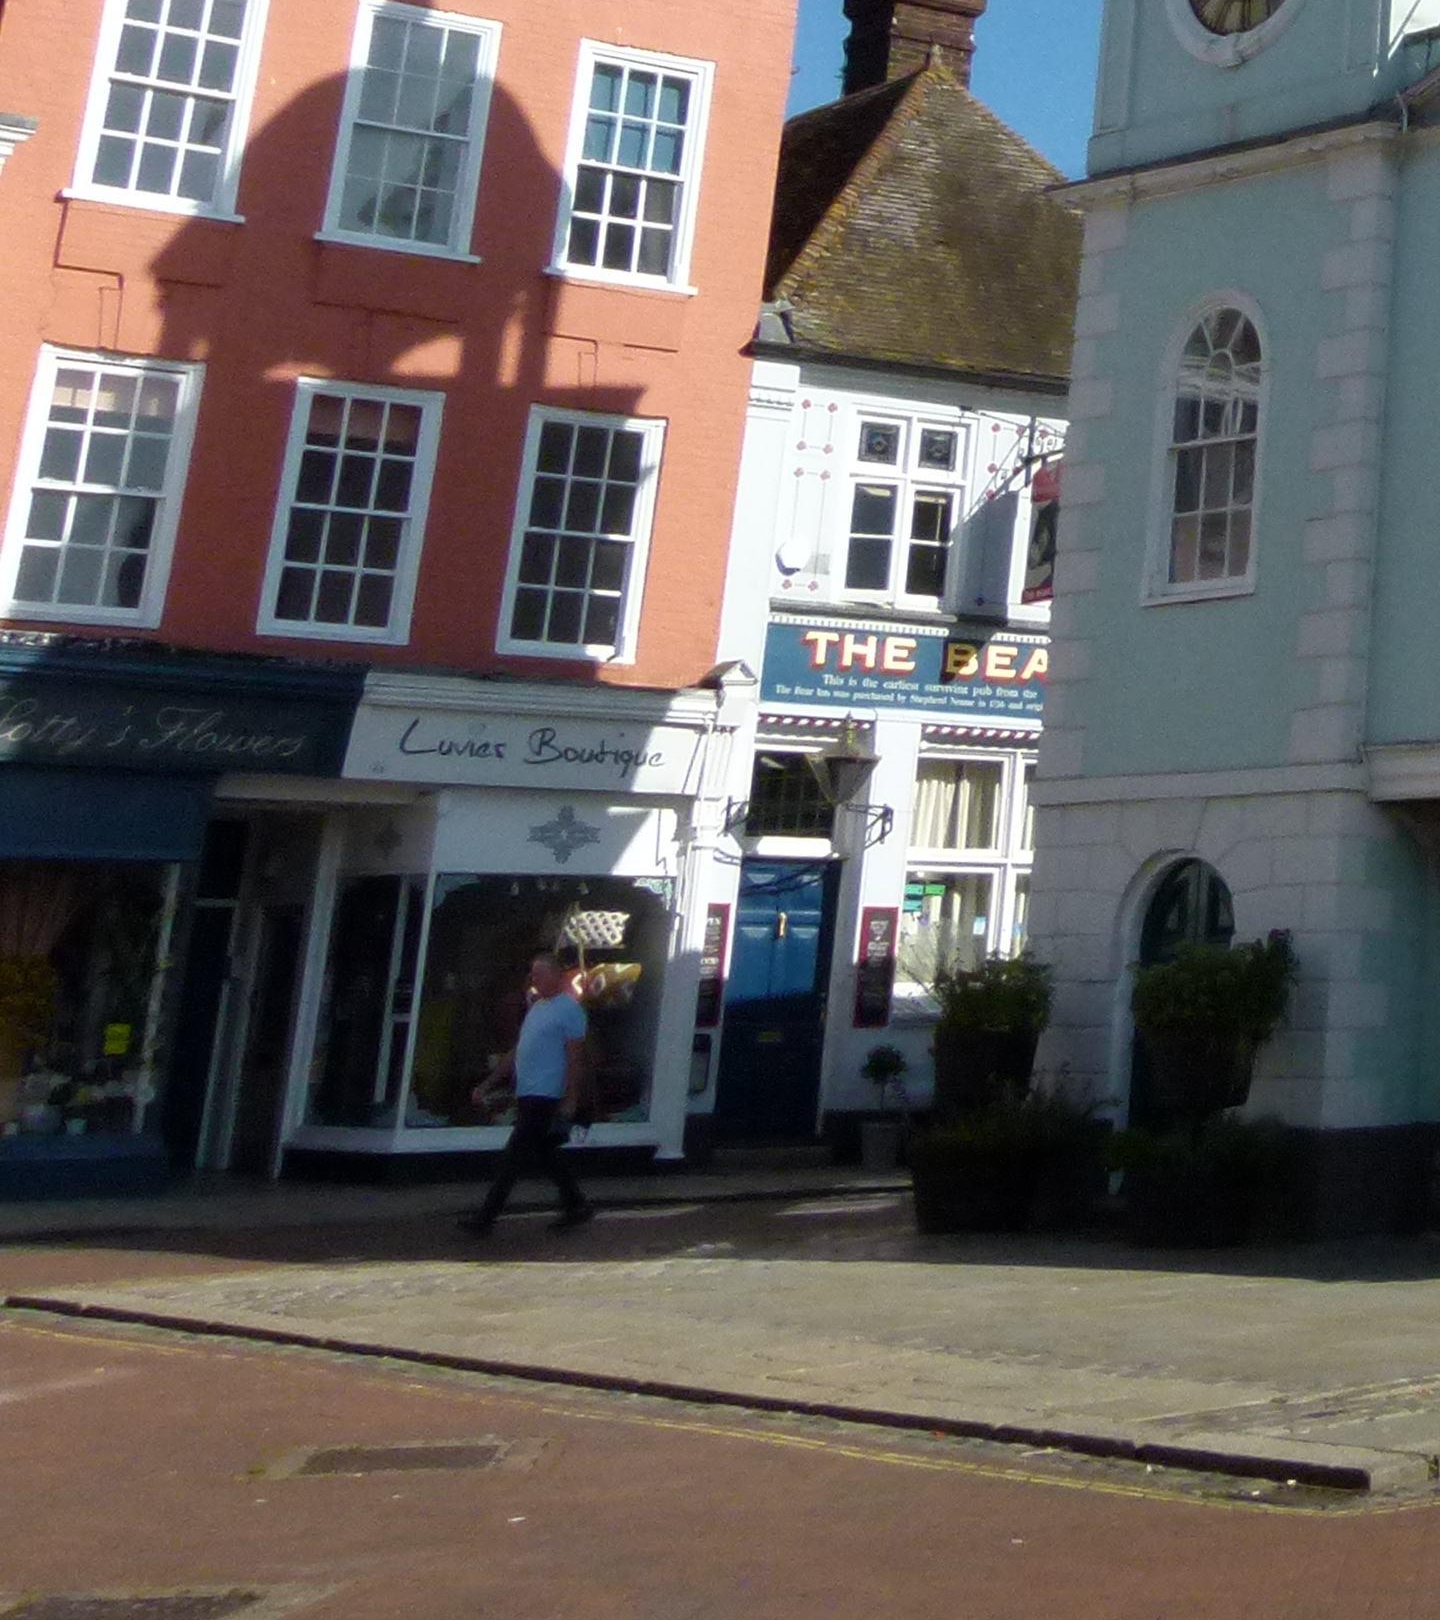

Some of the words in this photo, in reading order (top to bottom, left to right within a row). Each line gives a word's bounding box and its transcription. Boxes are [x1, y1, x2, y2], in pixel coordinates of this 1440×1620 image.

[803, 631, 917, 674] THE
[823, 673, 845, 686] This
[972, 684, 993, 697] pub
[138, 705, 307, 758] Flowers
[523, 726, 666, 777] Boutique
